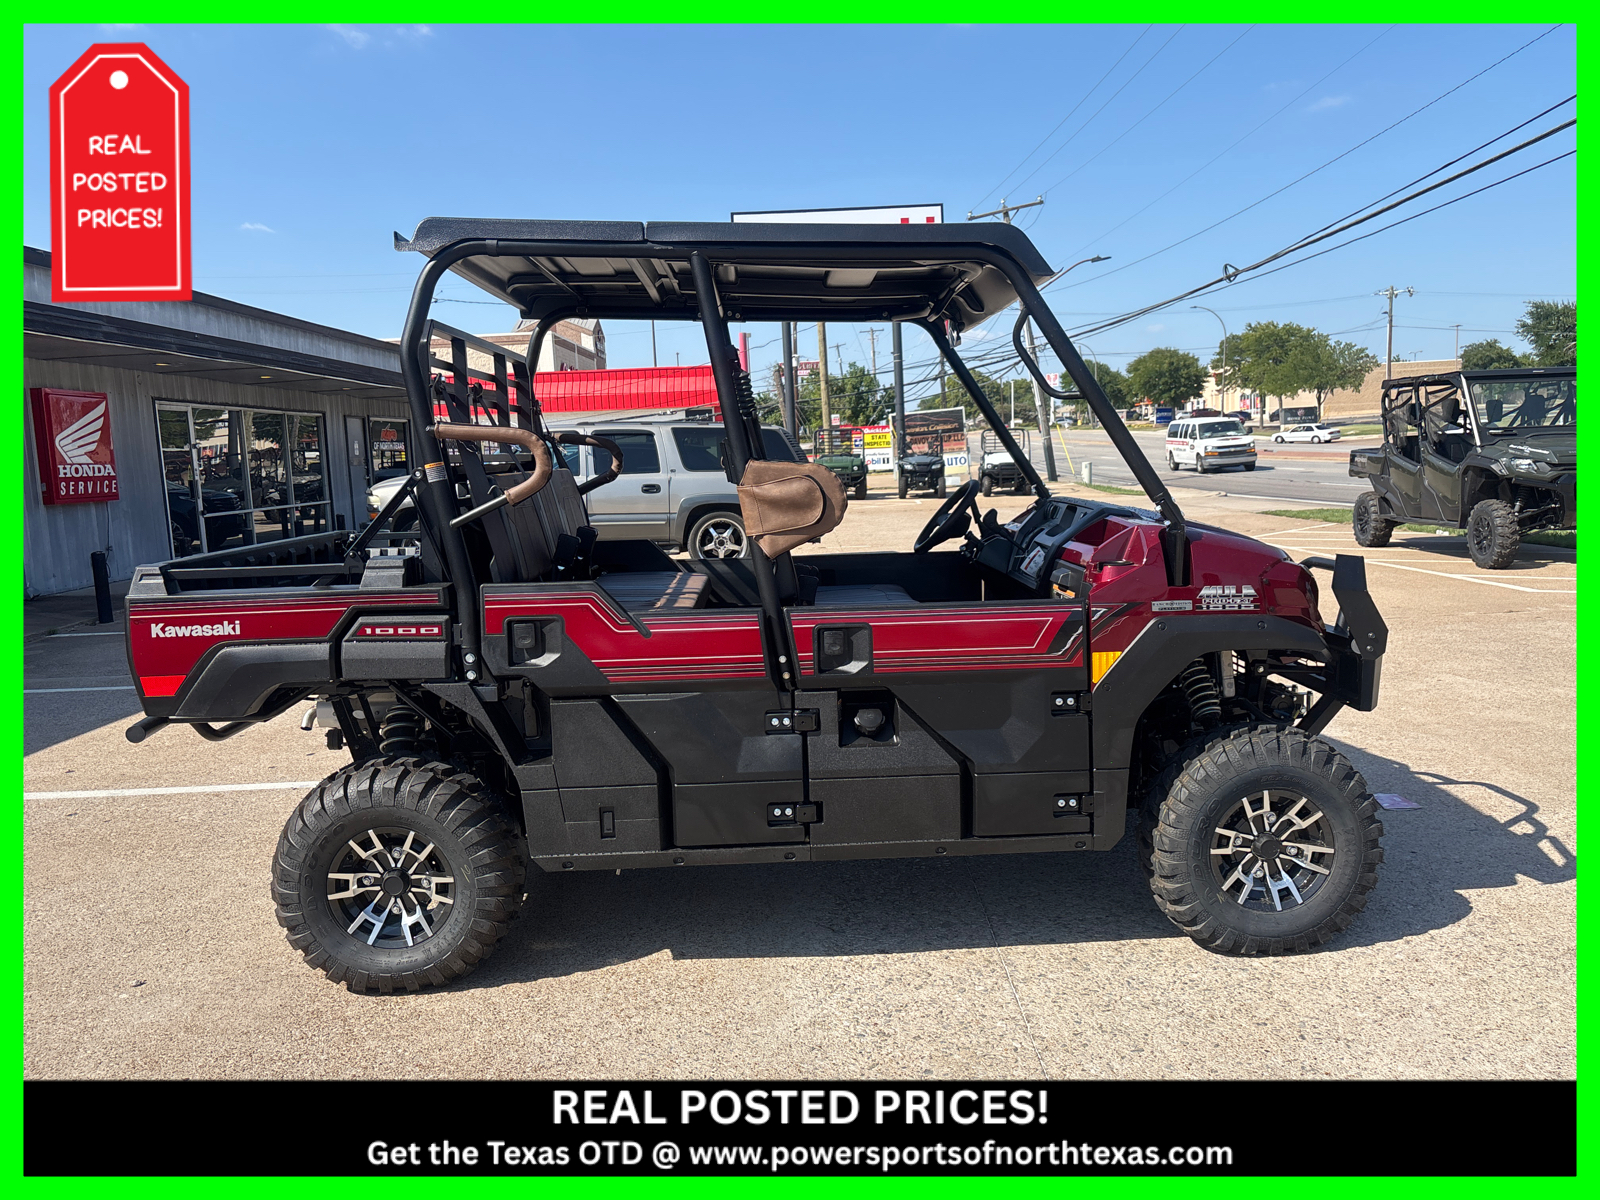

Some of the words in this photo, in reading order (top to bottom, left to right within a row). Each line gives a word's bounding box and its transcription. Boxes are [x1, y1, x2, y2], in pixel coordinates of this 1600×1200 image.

[393, 442, 405, 450] TEXAS
[945, 456, 967, 466] UTO
[58, 464, 116, 477] HONDA
[60, 480, 117, 496] SERVICE
[1196, 585, 1259, 598] MULE
[150, 620, 241, 638] Kawasaki
[365, 627, 439, 635] 1000
